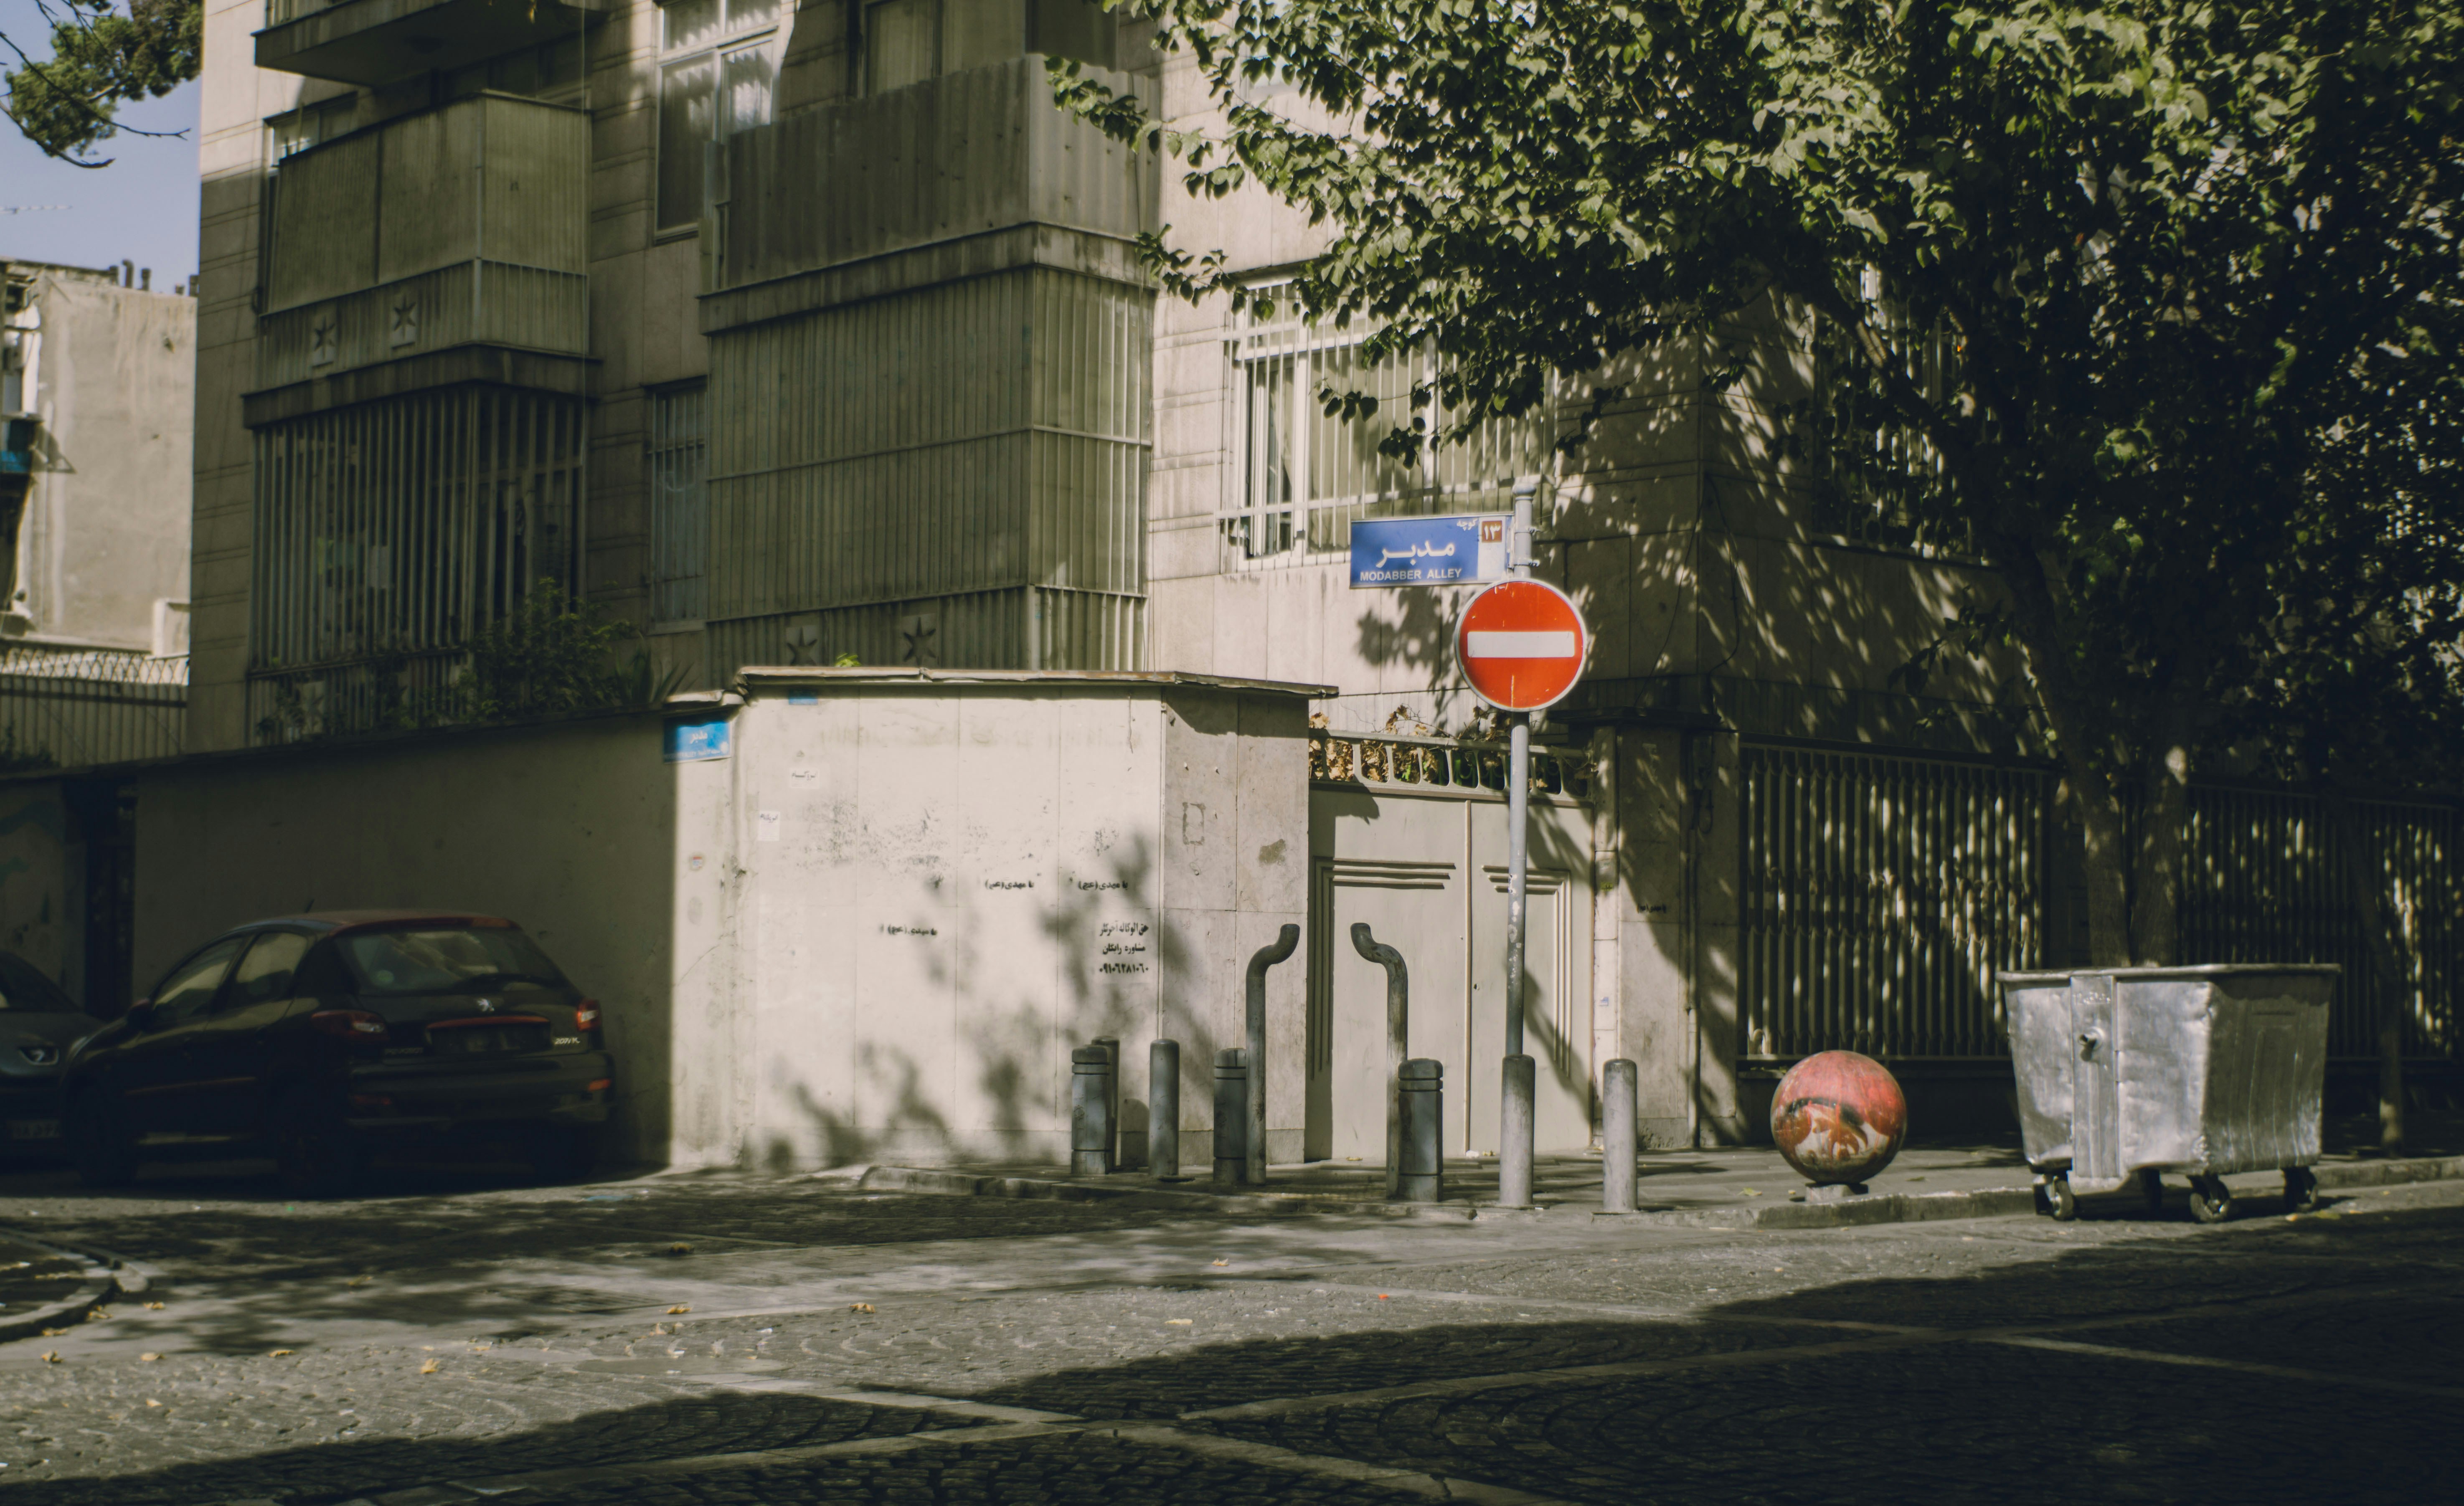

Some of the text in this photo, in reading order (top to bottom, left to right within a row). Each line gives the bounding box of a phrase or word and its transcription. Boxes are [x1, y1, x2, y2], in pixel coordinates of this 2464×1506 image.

[1457, 518, 1478, 531] کوچه
[1484, 524, 1501, 540] ۱۳
[1375, 540, 1455, 568] مدبر
[1360, 568, 1462, 581] MODABBER ALLEY
[1103, 942, 1146, 955] مشاوره رایگان
